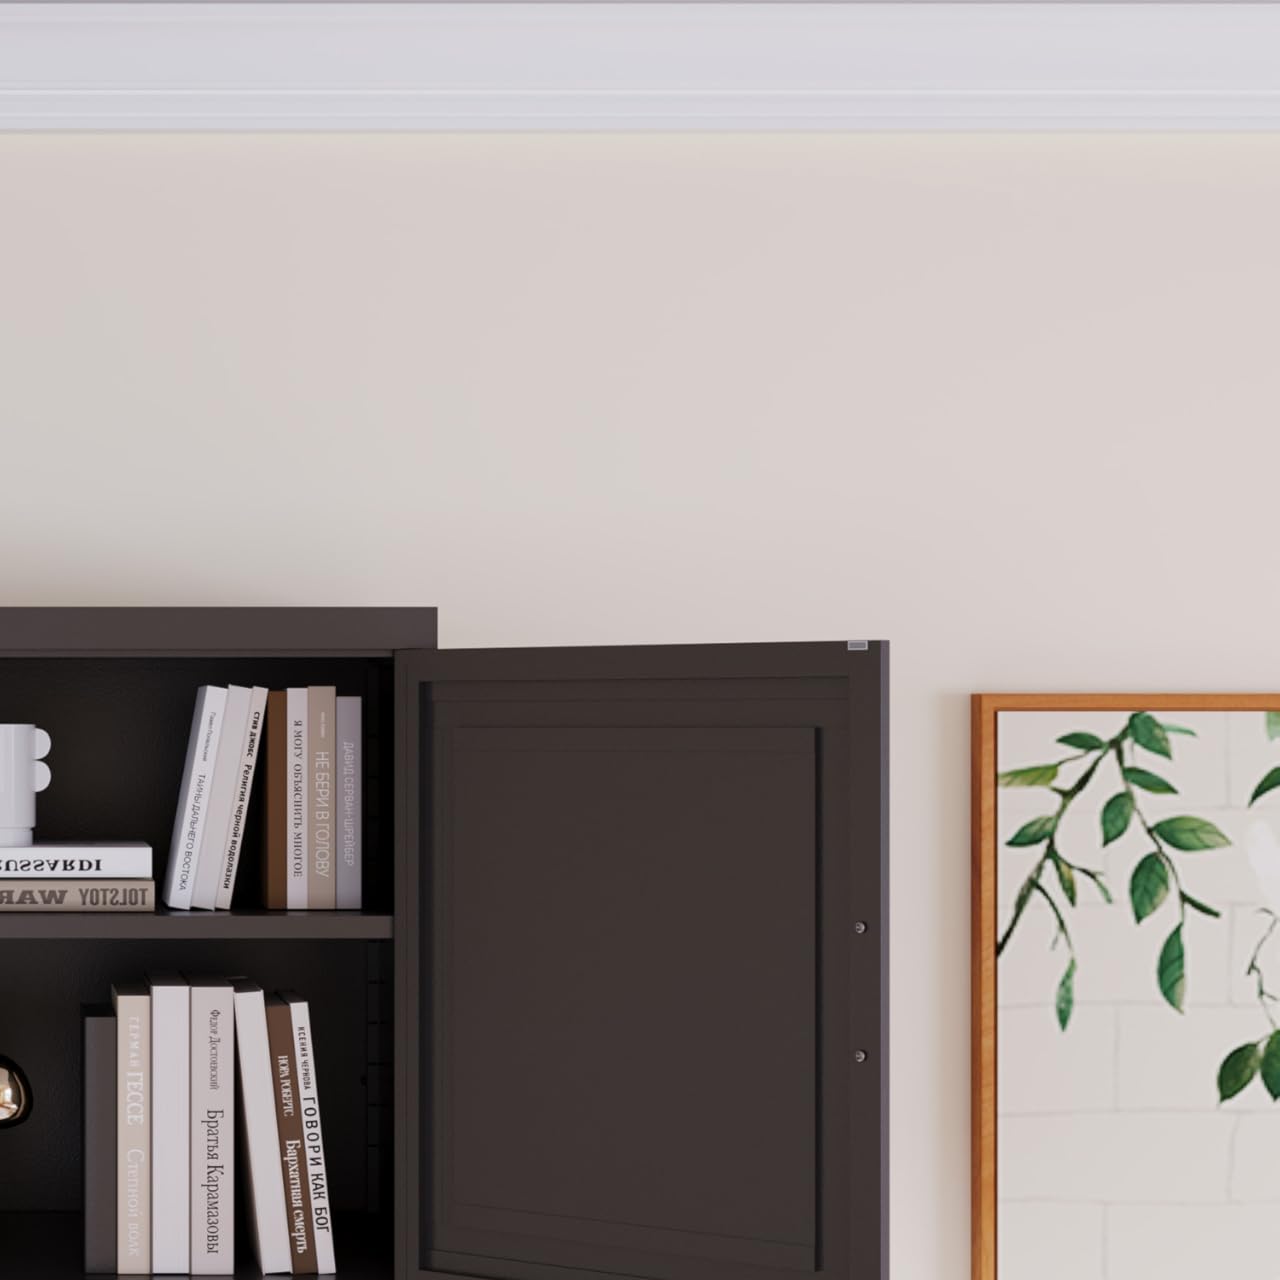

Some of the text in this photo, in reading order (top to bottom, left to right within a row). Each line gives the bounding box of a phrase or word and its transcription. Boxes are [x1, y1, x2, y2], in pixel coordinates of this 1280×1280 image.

[294, 730, 303, 759] МОГУ
[344, 742, 354, 774] ДАВИД
[294, 763, 303, 828] ОБЪЯСНИТЬ
[314, 751, 330, 877] НЕ БЕРИ В ГОЛОВУ
[186, 804, 200, 850] ДАЛЬНЕГО
[222, 764, 253, 889] Религия черной водолазки
[294, 832, 303, 877] МНОГОЕ
[179, 850, 192, 890] ВОСТОКА
[297, 1026, 311, 1090] КСЕНИЯ ЧЕРНОВА
[126, 1070, 144, 1126] ГЕССЕ
[280, 1079, 294, 1116] РОБЕРТС
[200, 1109, 224, 1254] Братья Карамазовы
[302, 1096, 330, 1232] ГОВОРИ КАК БОГ
[283, 1139, 308, 1254] Бархатная смерть
